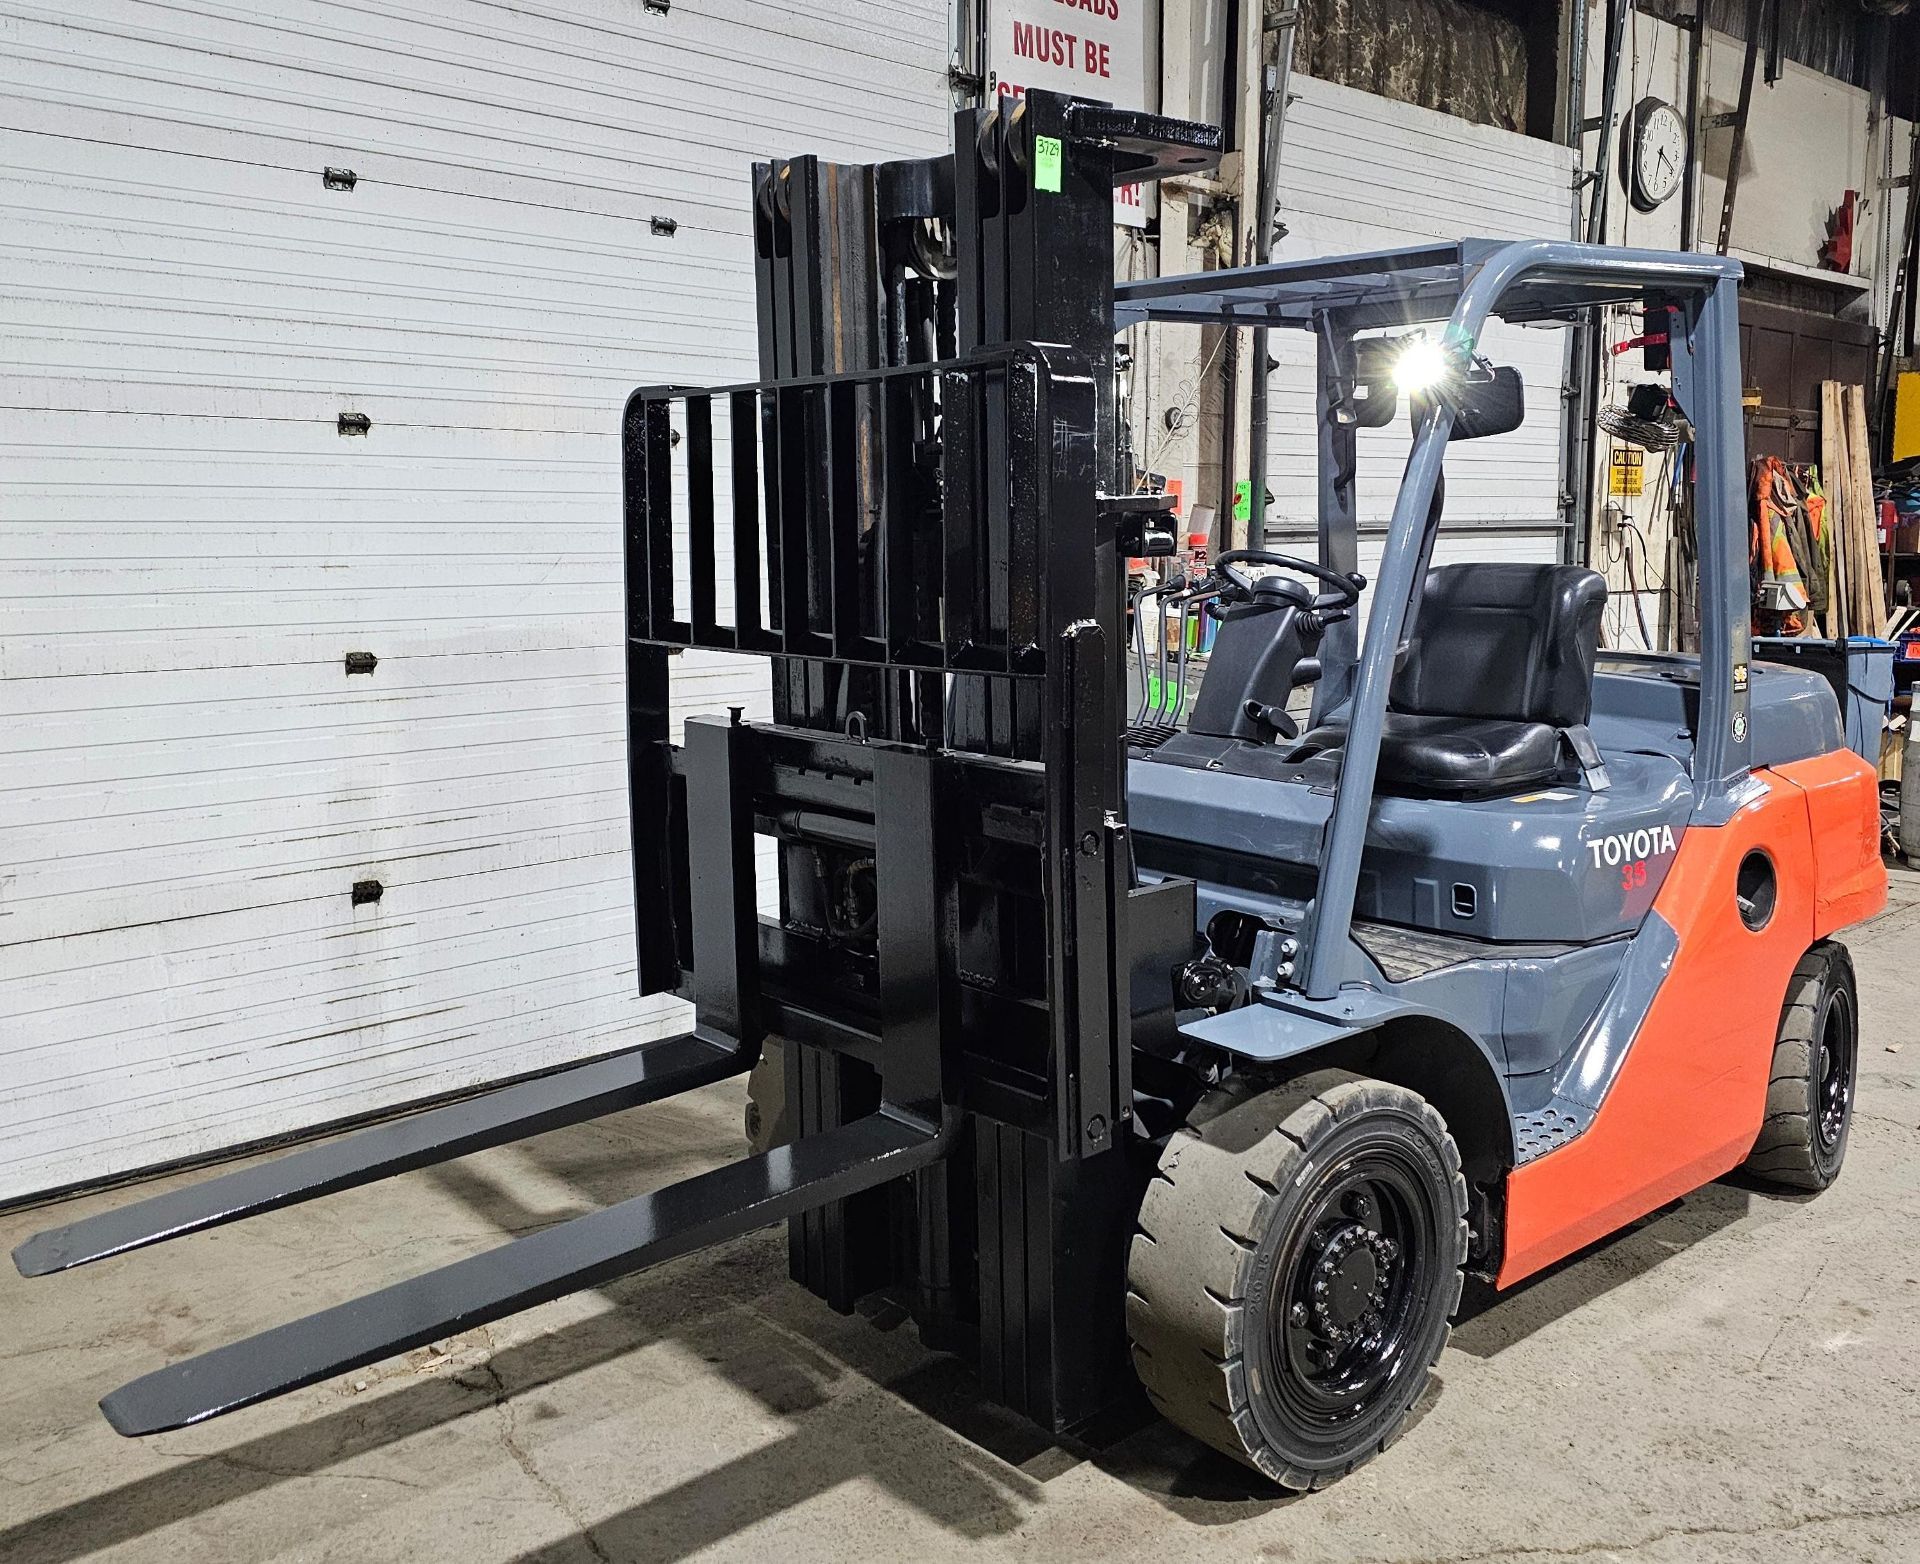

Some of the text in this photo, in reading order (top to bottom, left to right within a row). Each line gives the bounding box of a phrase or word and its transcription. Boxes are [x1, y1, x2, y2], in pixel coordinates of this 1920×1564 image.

[1014, 21, 1110, 78] MUST BE
[1661, 114, 1668, 126] 12
[1037, 139, 1060, 156] 3729
[1615, 451, 1642, 465] CAUTION
[1586, 825, 1676, 868] TOYOTA
[1622, 860, 1647, 890] 35
